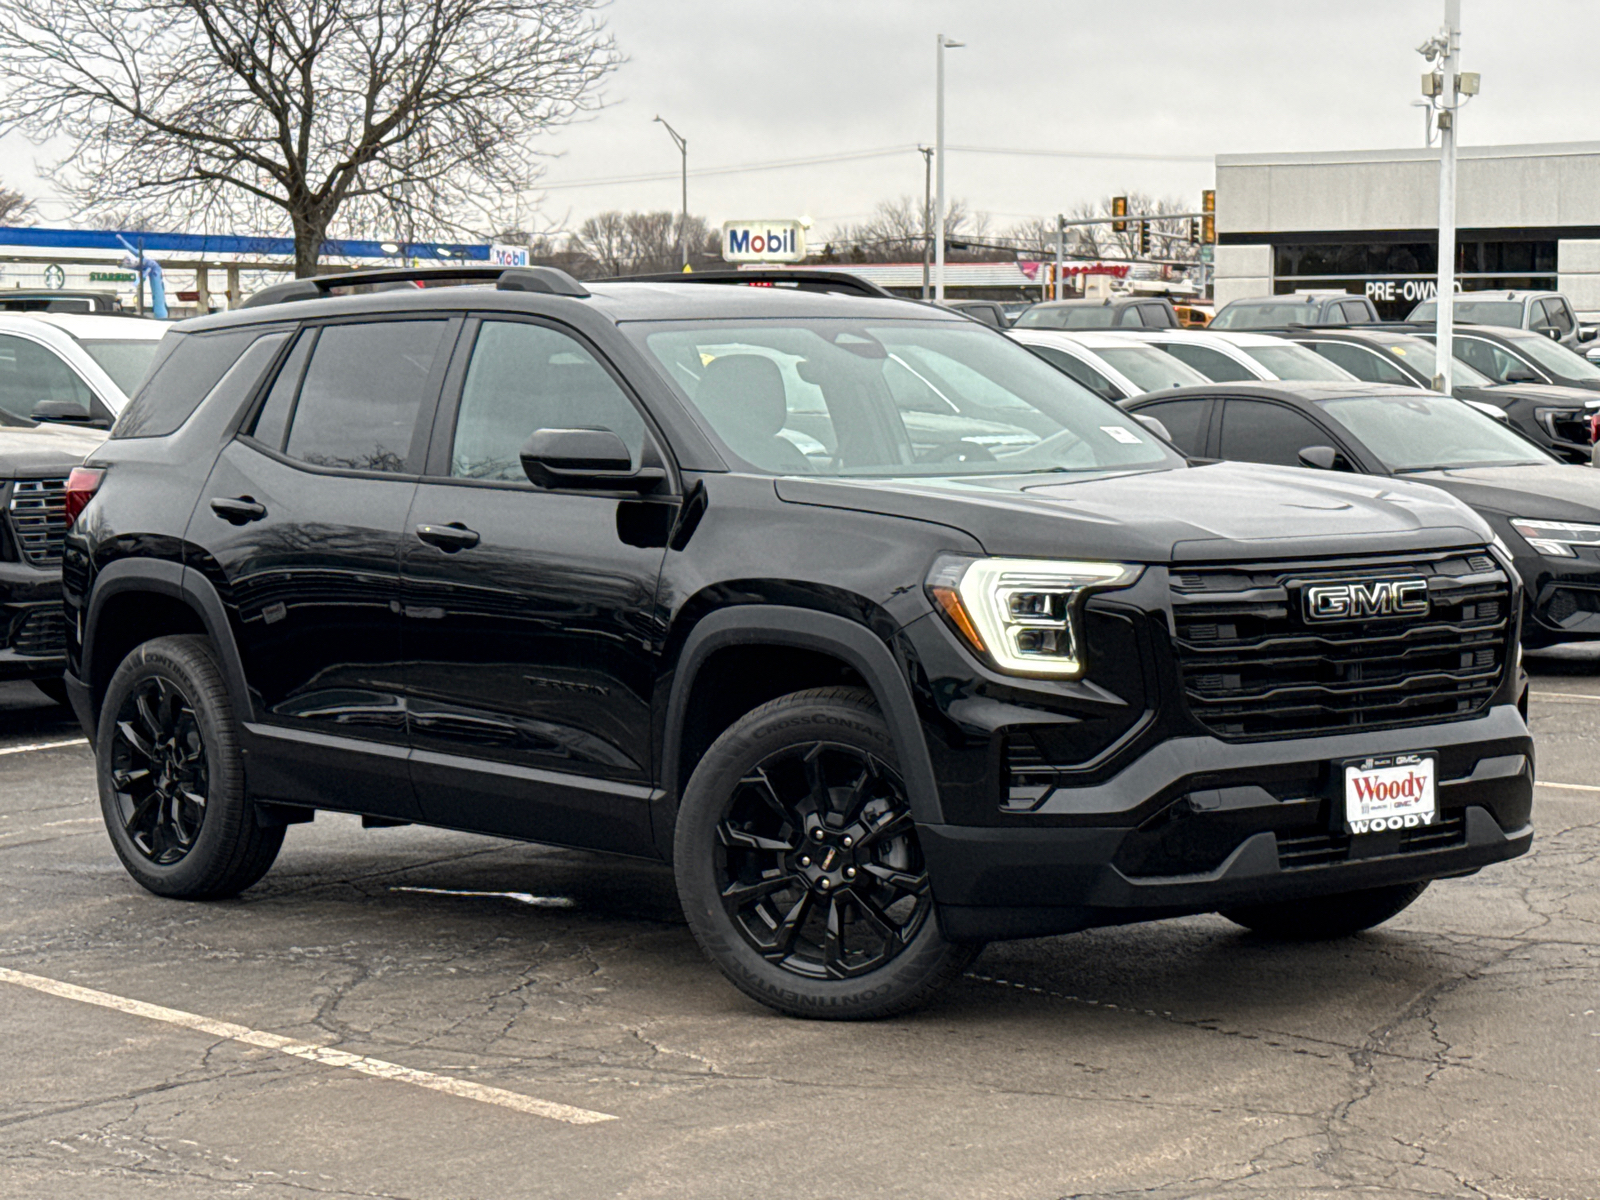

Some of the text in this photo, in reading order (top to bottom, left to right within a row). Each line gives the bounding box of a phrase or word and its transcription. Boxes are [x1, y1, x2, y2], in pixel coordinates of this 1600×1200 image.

[729, 228, 795, 253] Mobil
[1308, 580, 1428, 618] GMC
[1352, 771, 1427, 803] Woody
[1350, 812, 1435, 835] WOODY
